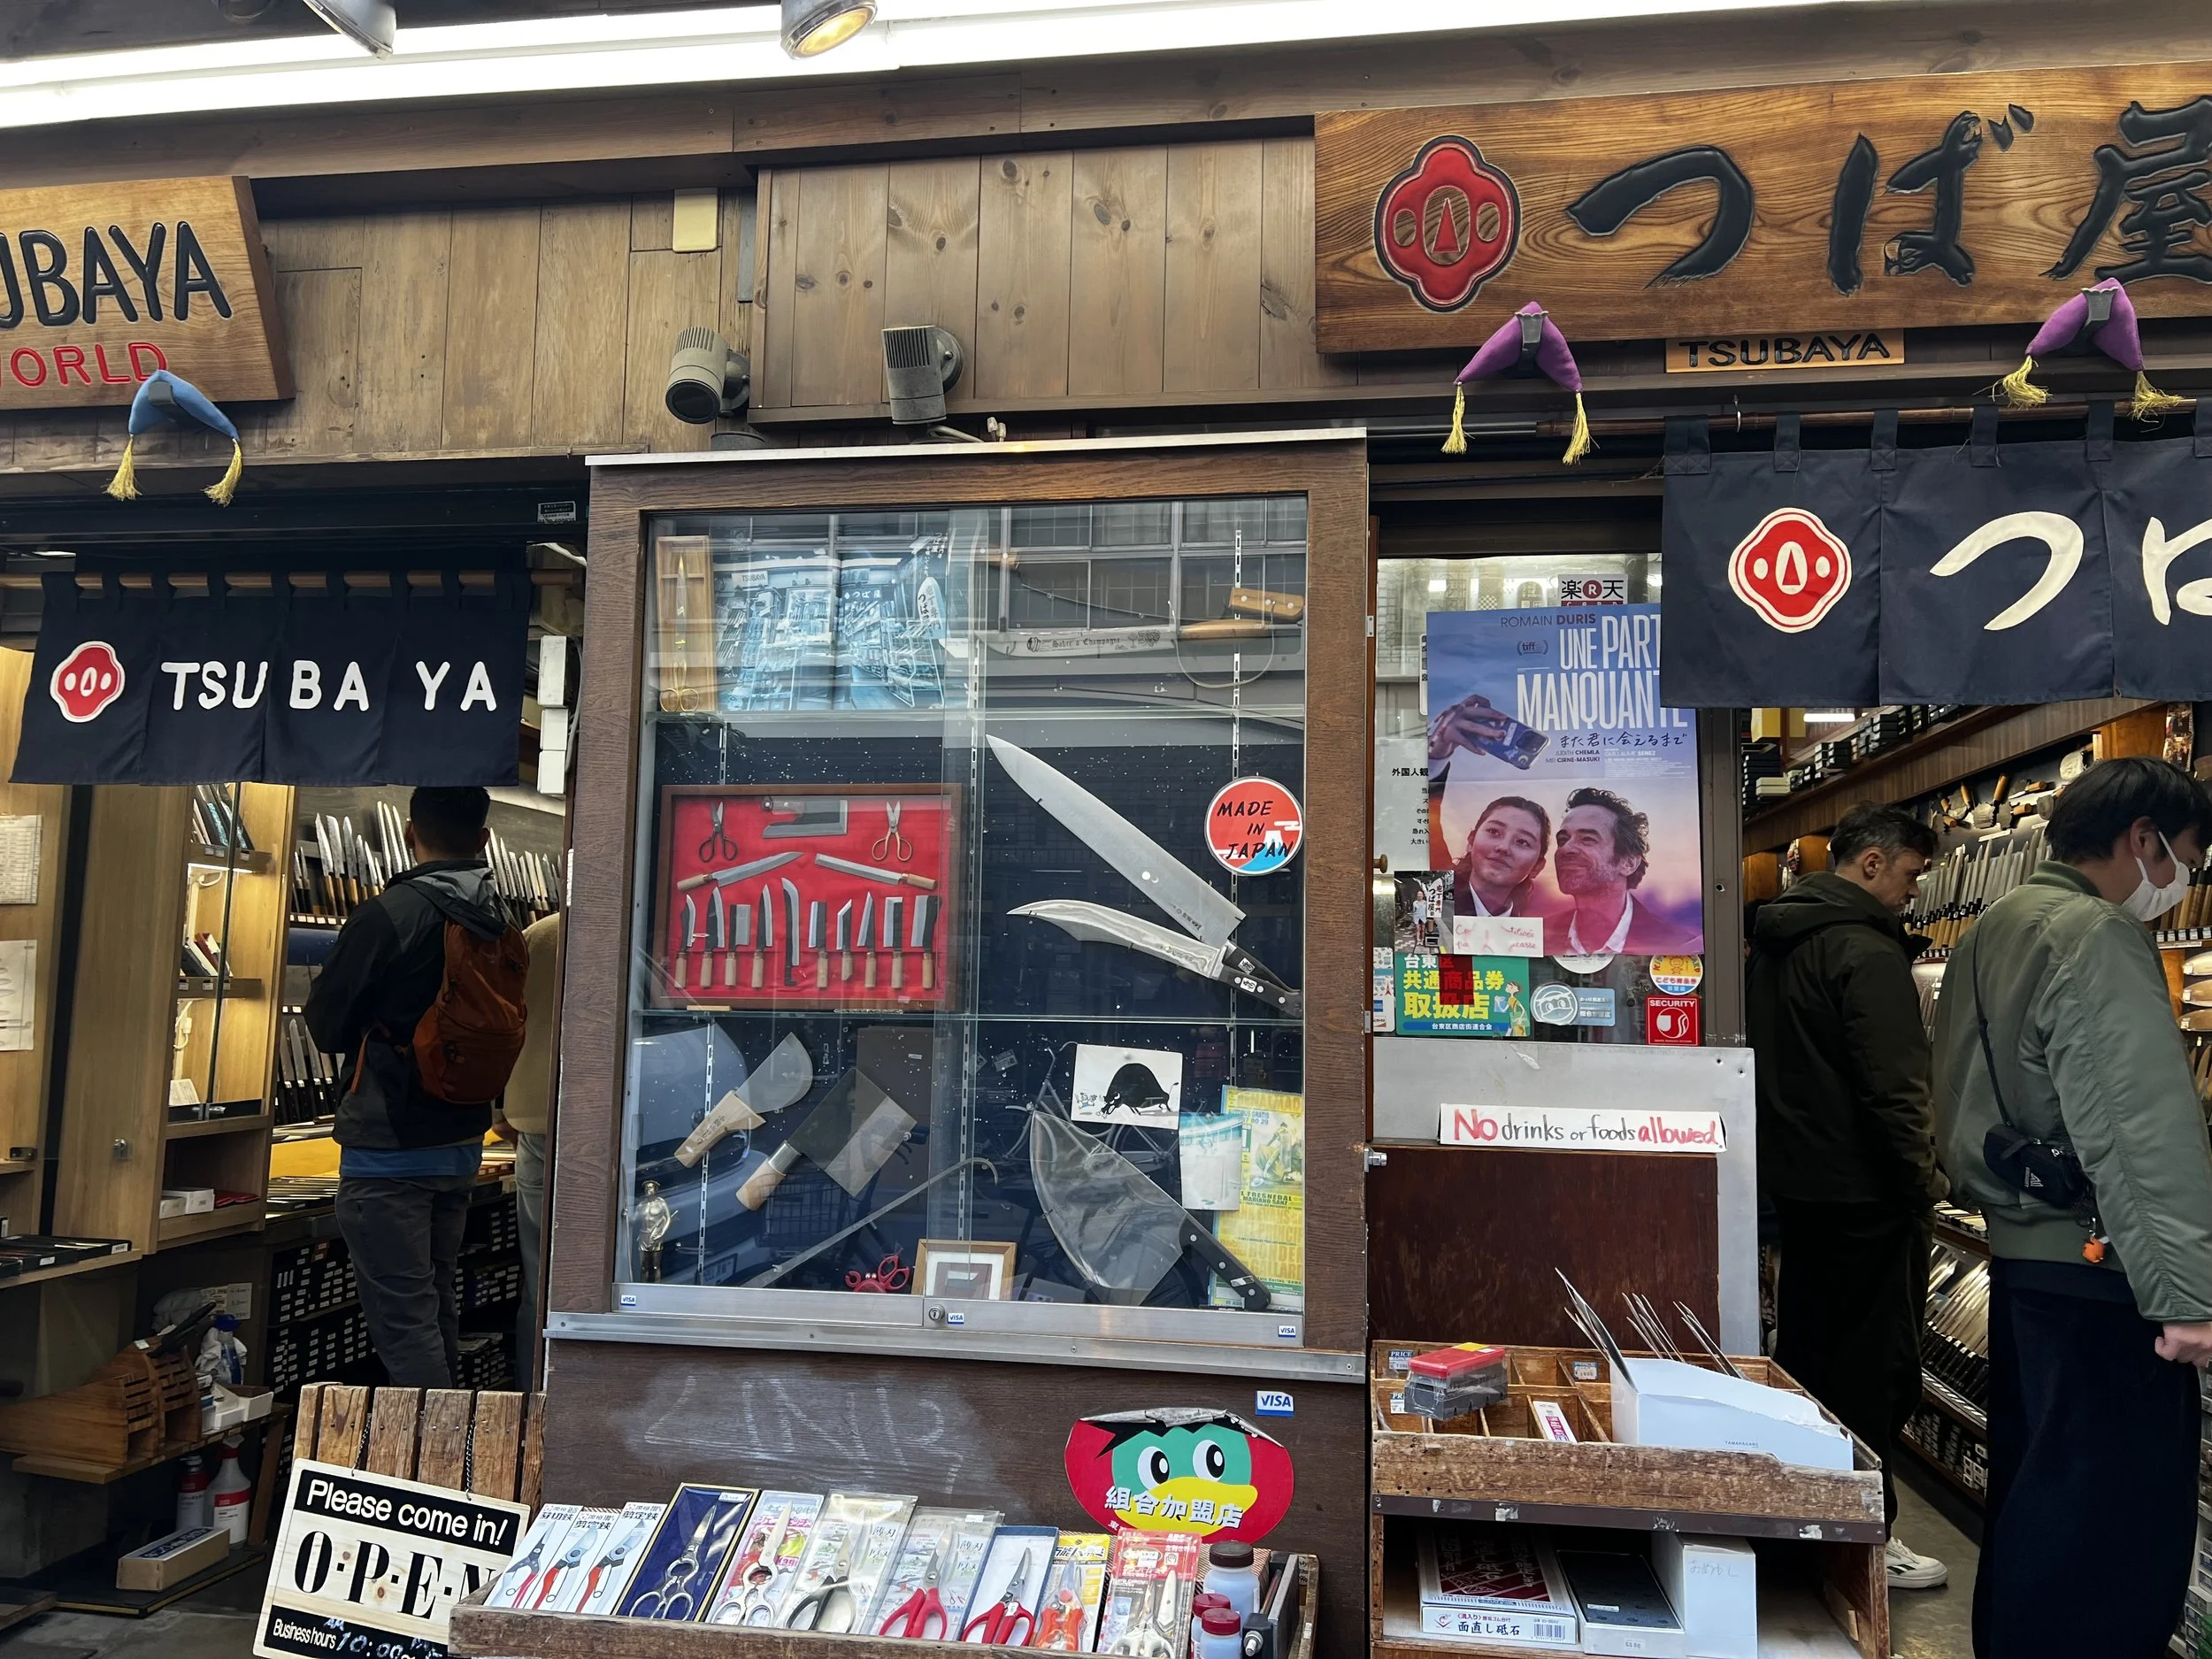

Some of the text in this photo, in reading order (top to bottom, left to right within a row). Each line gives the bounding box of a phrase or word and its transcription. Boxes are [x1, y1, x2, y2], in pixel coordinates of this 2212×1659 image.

[1566, 96, 2212, 296] つば屋
[1678, 333, 1892, 368] TSUBAYA
[0, 342, 167, 388] ORLD
[1501, 613, 1596, 627] ROMAIN DURIS
[1521, 641, 1536, 651] tiff
[1560, 628, 1598, 671] UNE
[1560, 731, 1687, 748] また君に会えるまで
[1217, 801, 1273, 817] MADE
[1247, 823, 1264, 835] IN
[1225, 841, 1294, 860] JAPAN
[1404, 953, 1455, 969] 台東区
[1403, 970, 1504, 991] 共通商品券
[1403, 992, 1490, 1019] 取扱店
[1454, 1109, 1498, 1141] No
[1502, 1112, 1563, 1141] drinks
[1571, 1130, 1587, 1141] or
[1587, 1114, 1636, 1141] foods
[1260, 1395, 1291, 1408] VISA
[306, 1479, 509, 1546] Please come in!
[1104, 1486, 1244, 1529] 組合加盟店
[273, 1618, 337, 1649] Business hours
[1458, 1620, 1521, 1636] 面直し砥石
